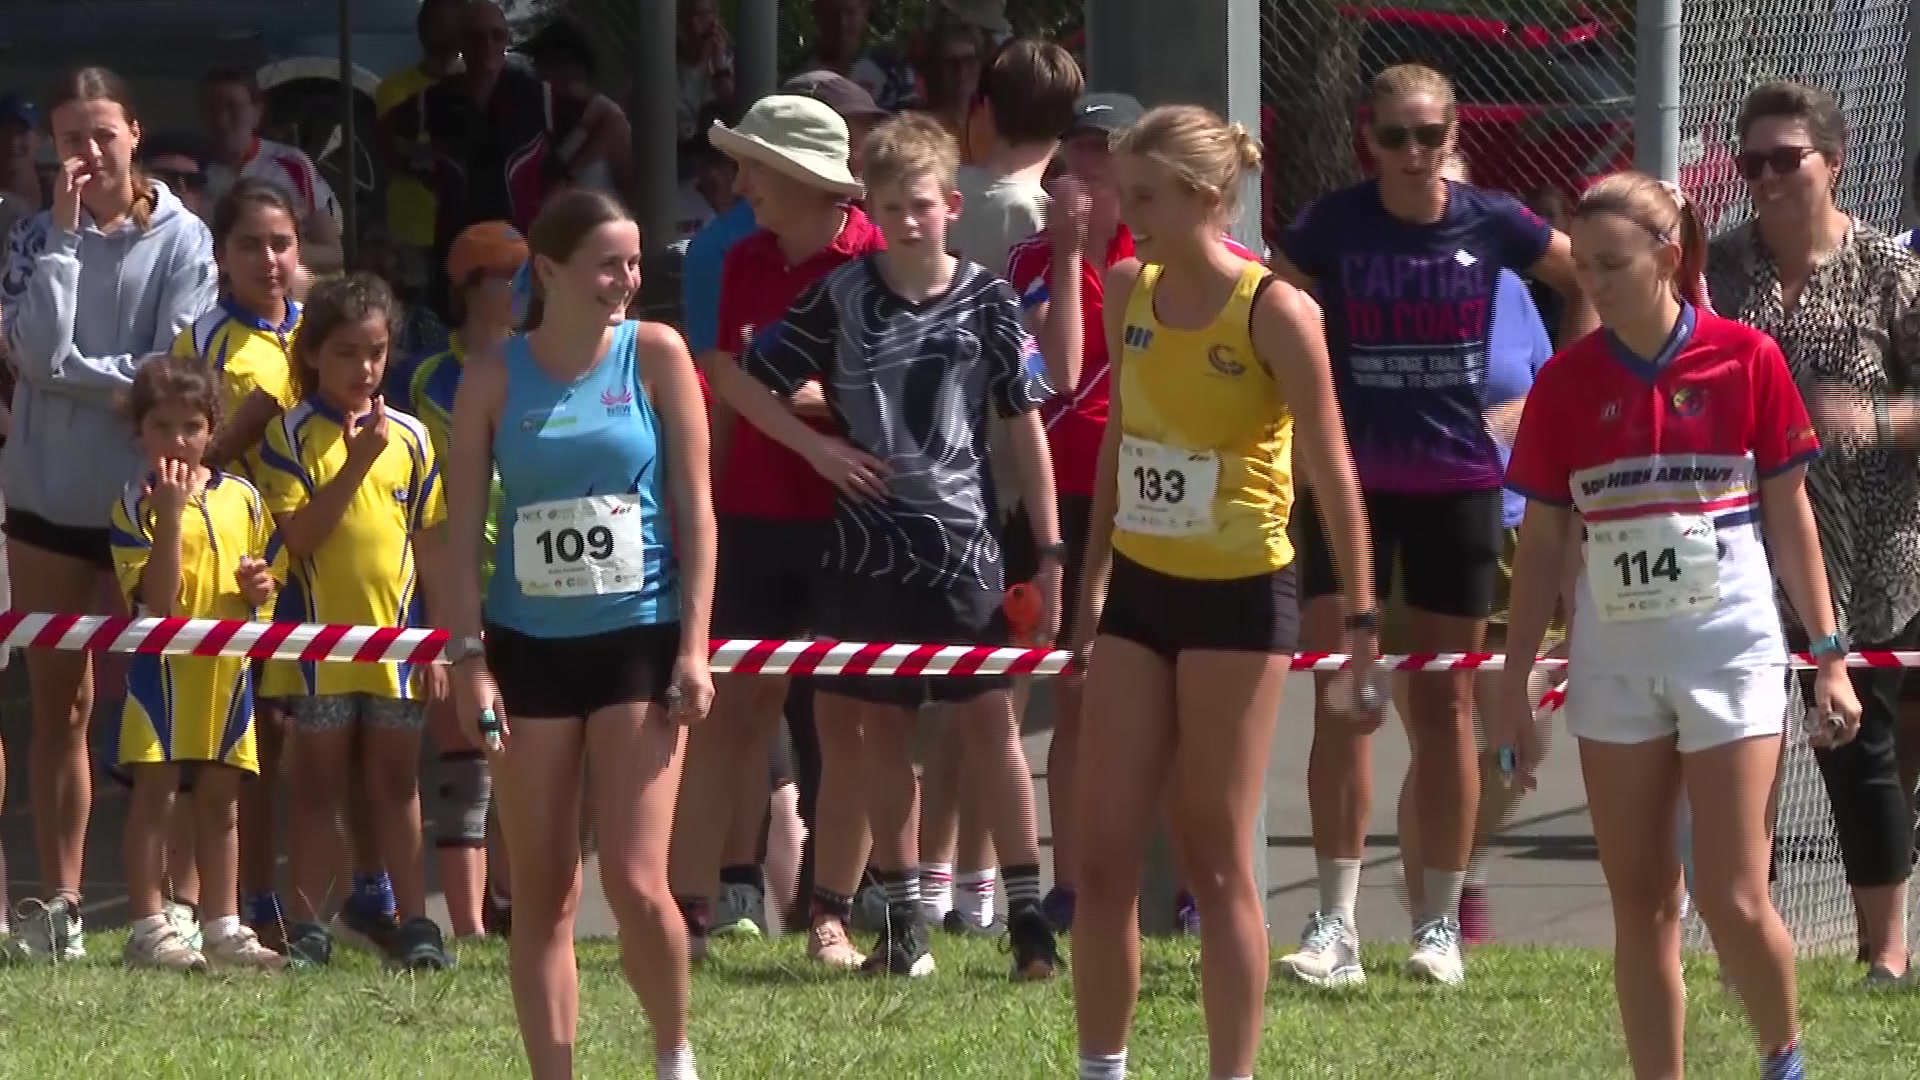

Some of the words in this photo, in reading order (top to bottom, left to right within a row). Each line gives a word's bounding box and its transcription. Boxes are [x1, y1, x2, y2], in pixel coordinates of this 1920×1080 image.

[1343, 253, 1488, 297] CAPITAL
[1345, 300, 1383, 341] TO
[1391, 297, 1488, 342] COAST
[1134, 466, 1186, 504] 133
[536, 524, 615, 564] 109
[1614, 546, 1681, 586] 114
